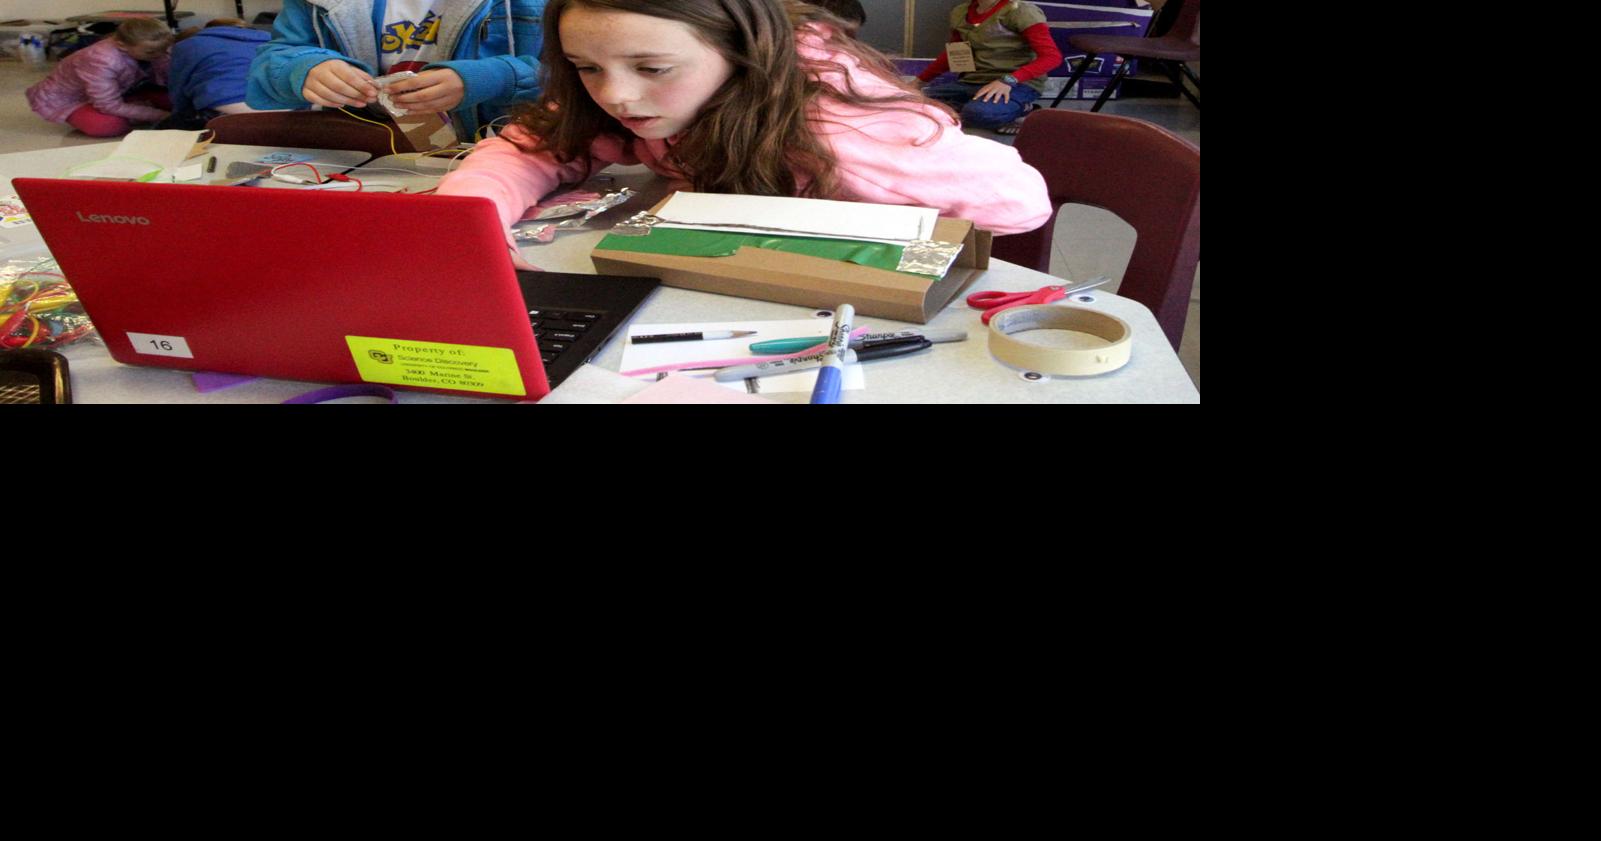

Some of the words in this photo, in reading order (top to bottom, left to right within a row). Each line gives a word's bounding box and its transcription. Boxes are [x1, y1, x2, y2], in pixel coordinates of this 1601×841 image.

[76, 211, 150, 225] Lenovo
[150, 340, 173, 351] 16
[393, 344, 444, 356] Property
[397, 354, 433, 363] Science
[434, 358, 478, 367] Discovery
